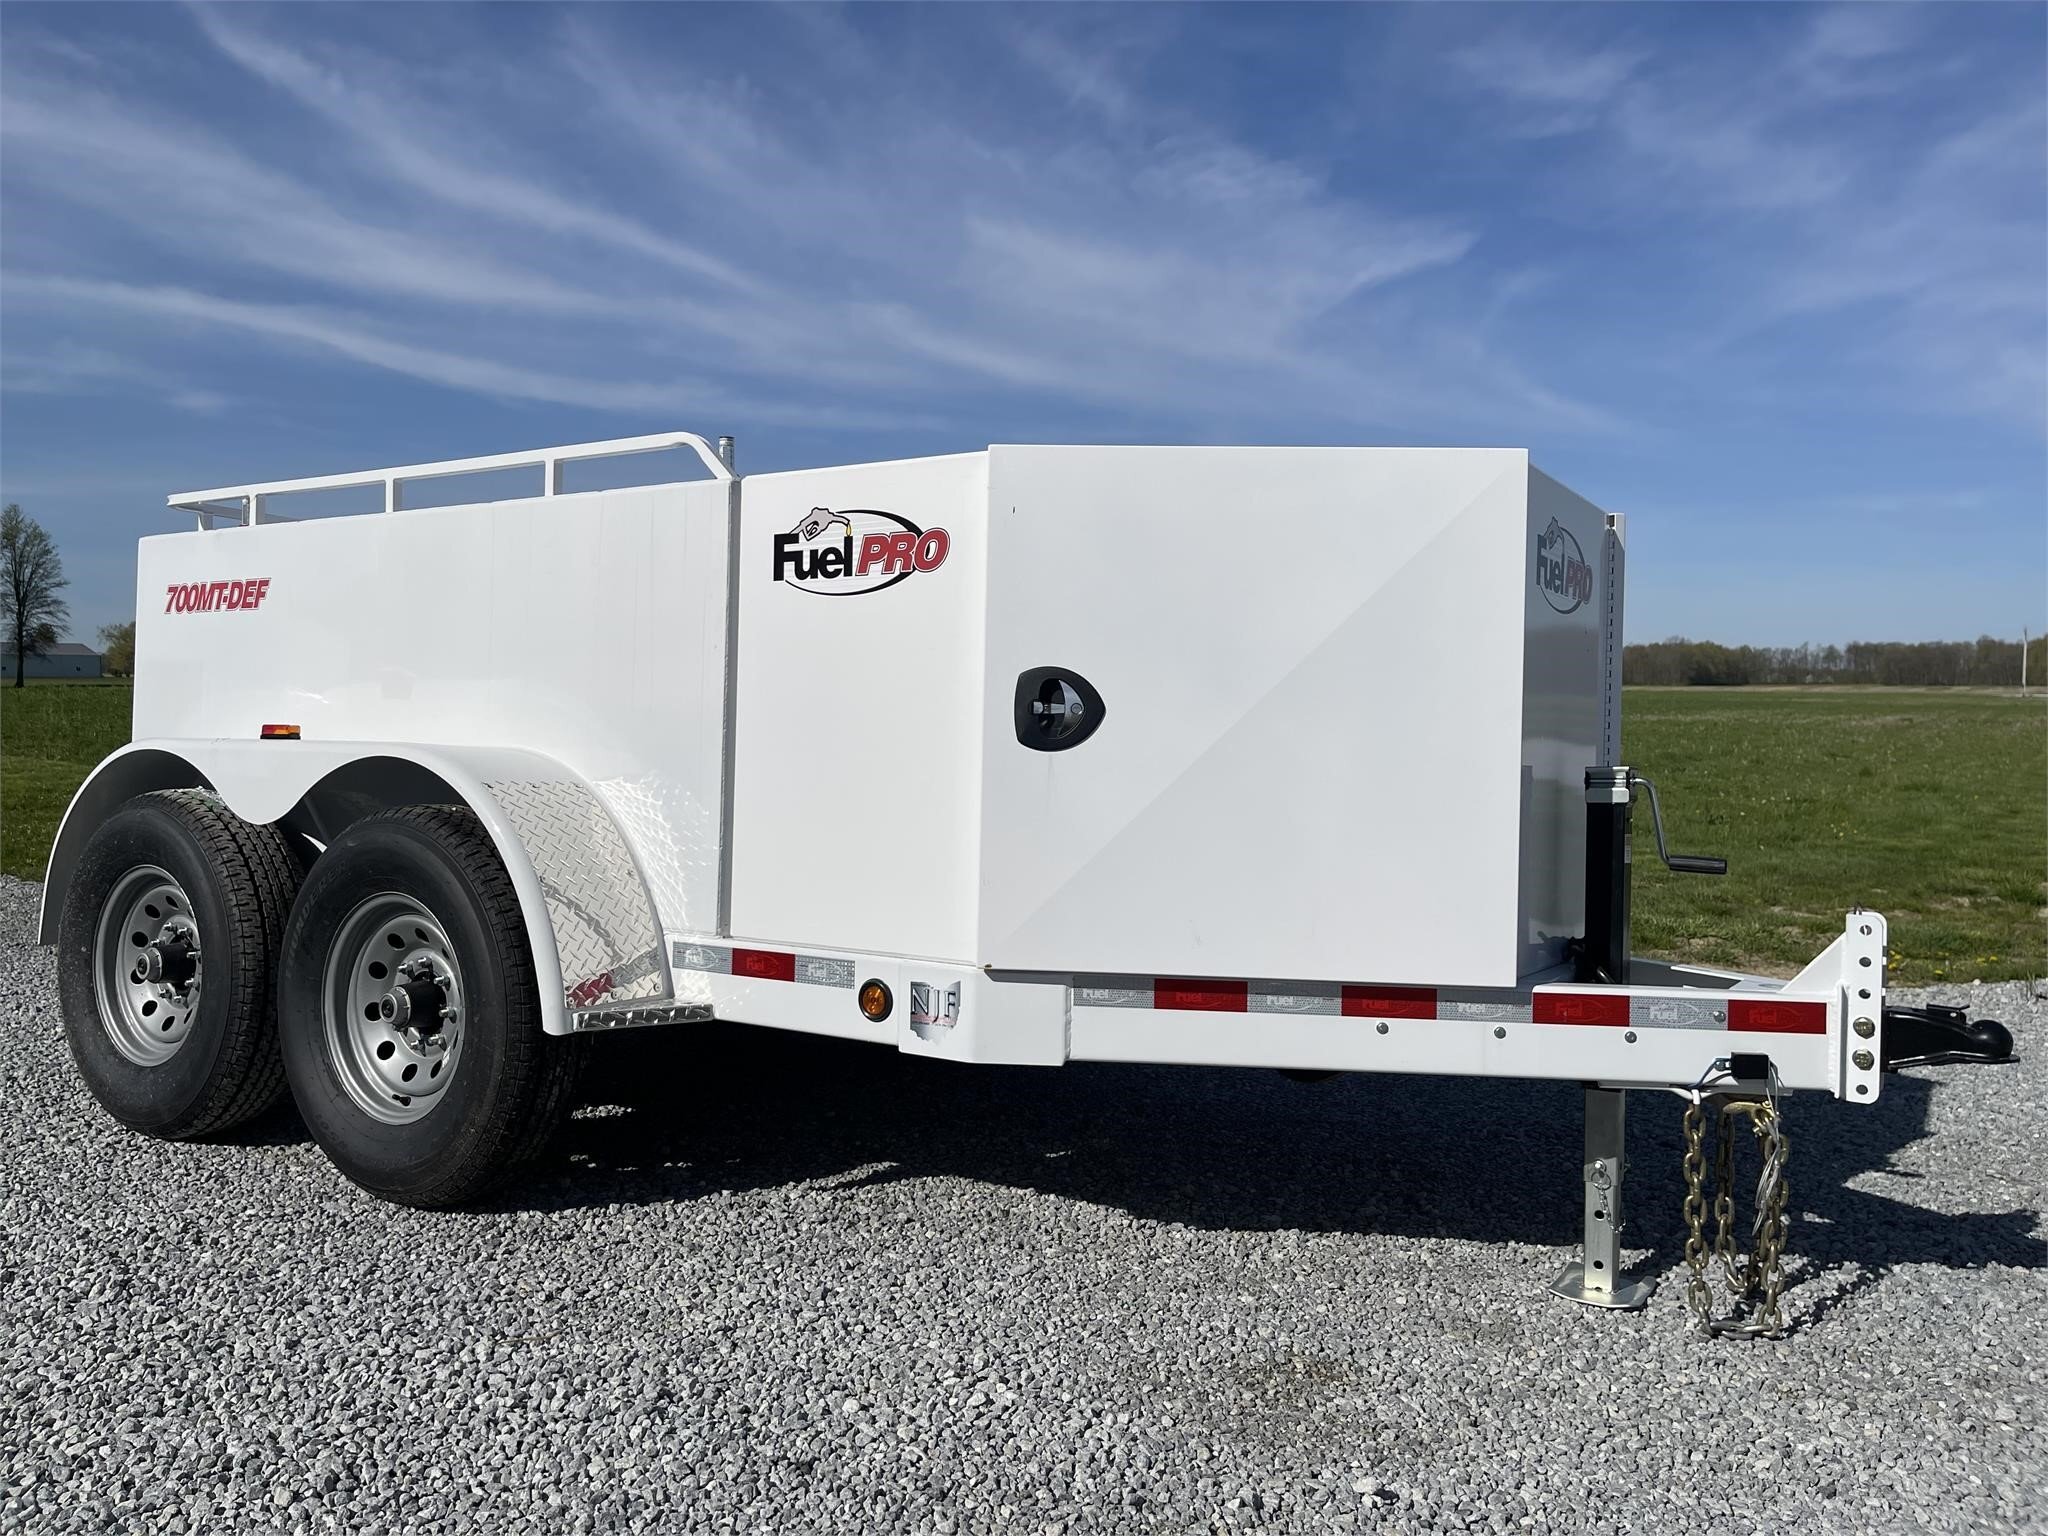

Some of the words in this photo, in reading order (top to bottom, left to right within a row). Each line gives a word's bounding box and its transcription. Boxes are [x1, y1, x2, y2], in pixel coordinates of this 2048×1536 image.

[773, 532, 854, 582] Fuel
[855, 527, 951, 577] PRO
[1536, 534, 1565, 595] Fuel
[1564, 555, 1593, 605] PRO
[164, 577, 272, 615] 700MT-DEF
[911, 987, 956, 1024] NJF
[1650, 1005, 1678, 1020] Fuel
